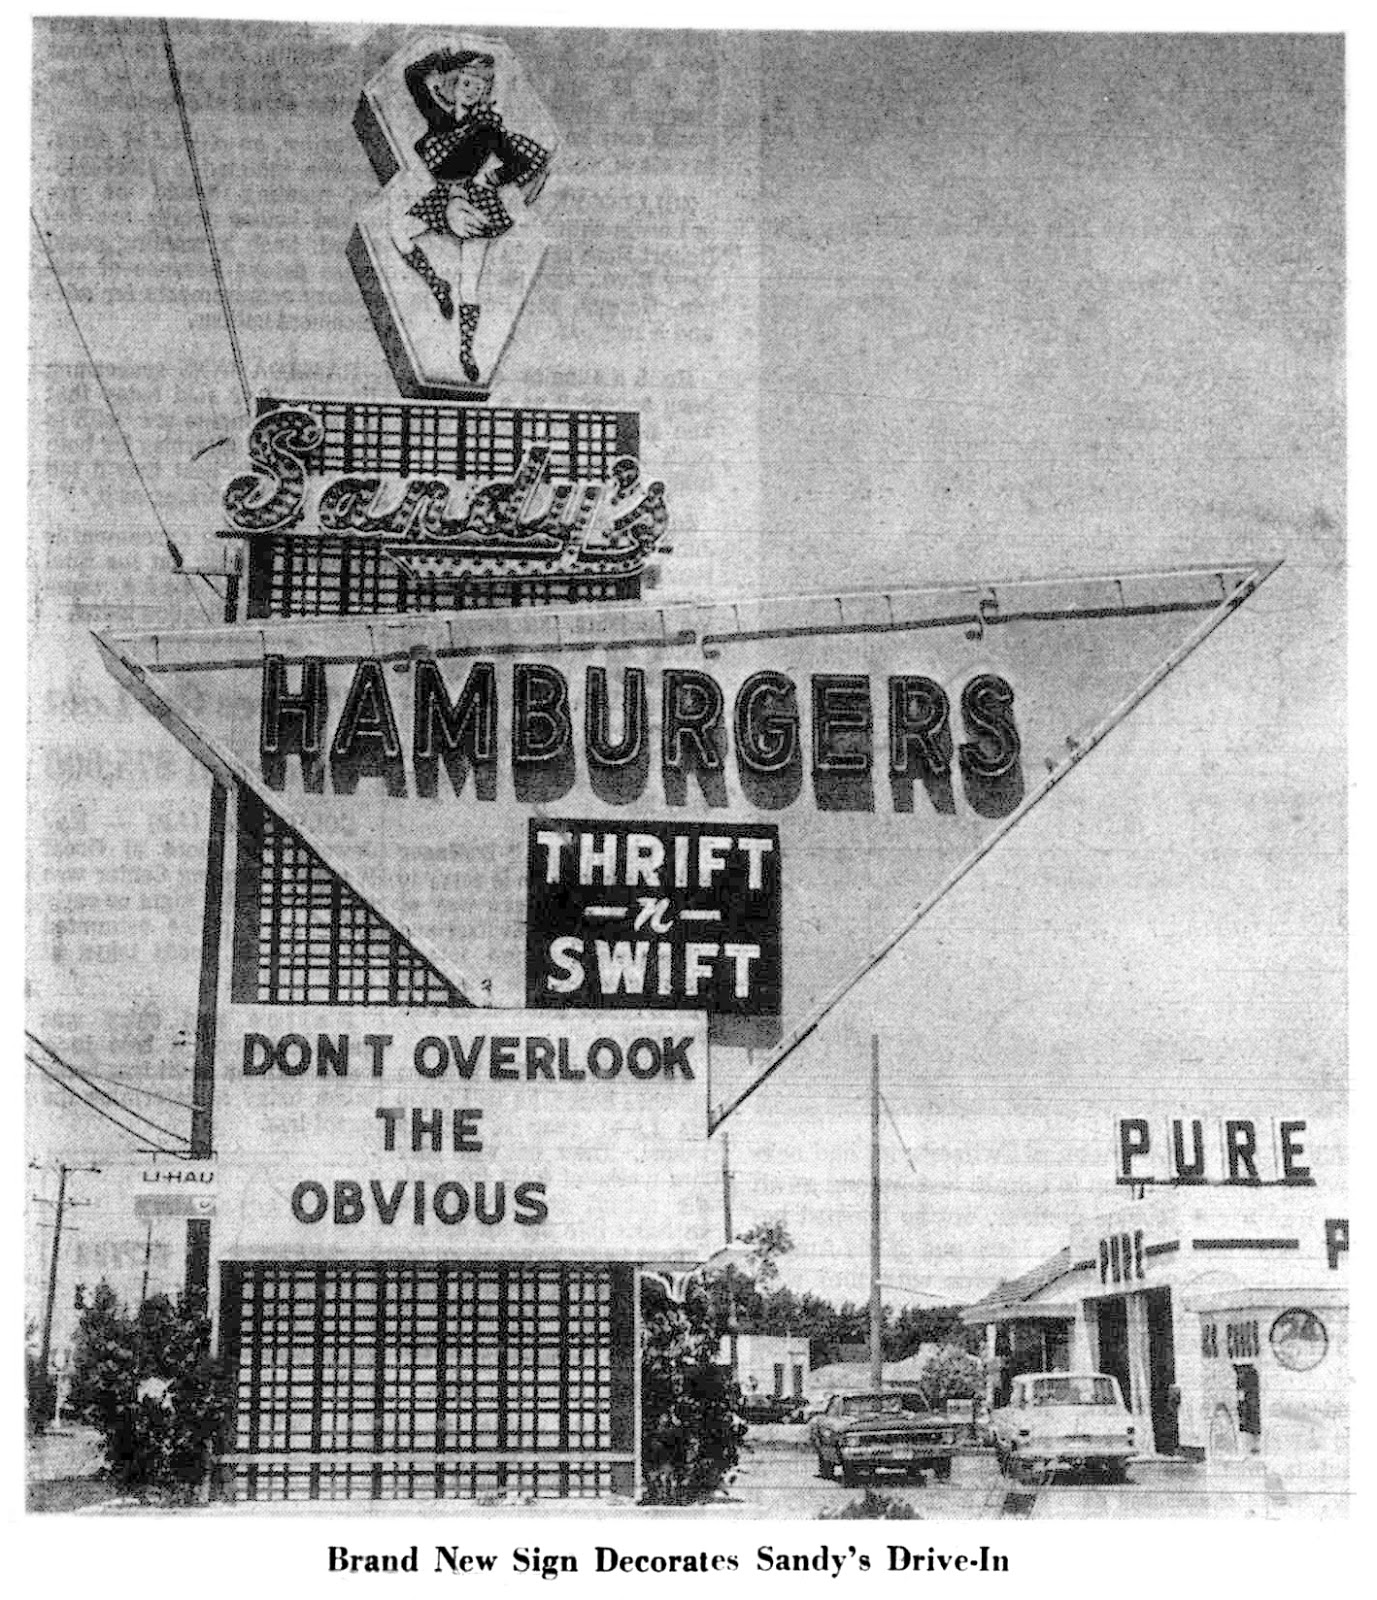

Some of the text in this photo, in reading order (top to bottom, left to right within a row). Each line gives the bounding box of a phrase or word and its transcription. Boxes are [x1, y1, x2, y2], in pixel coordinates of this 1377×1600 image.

[223, 408, 669, 580] Sandy's
[261, 654, 1022, 780] HAMBURGERS
[536, 830, 774, 890] THRIFT
[546, 935, 761, 999] SWIFT
[413, 1034, 697, 1081] OVERLOOK
[375, 1107, 484, 1152] THE
[1119, 1117, 1311, 1179] PURE
[290, 1179, 549, 1226] OBVIOUS
